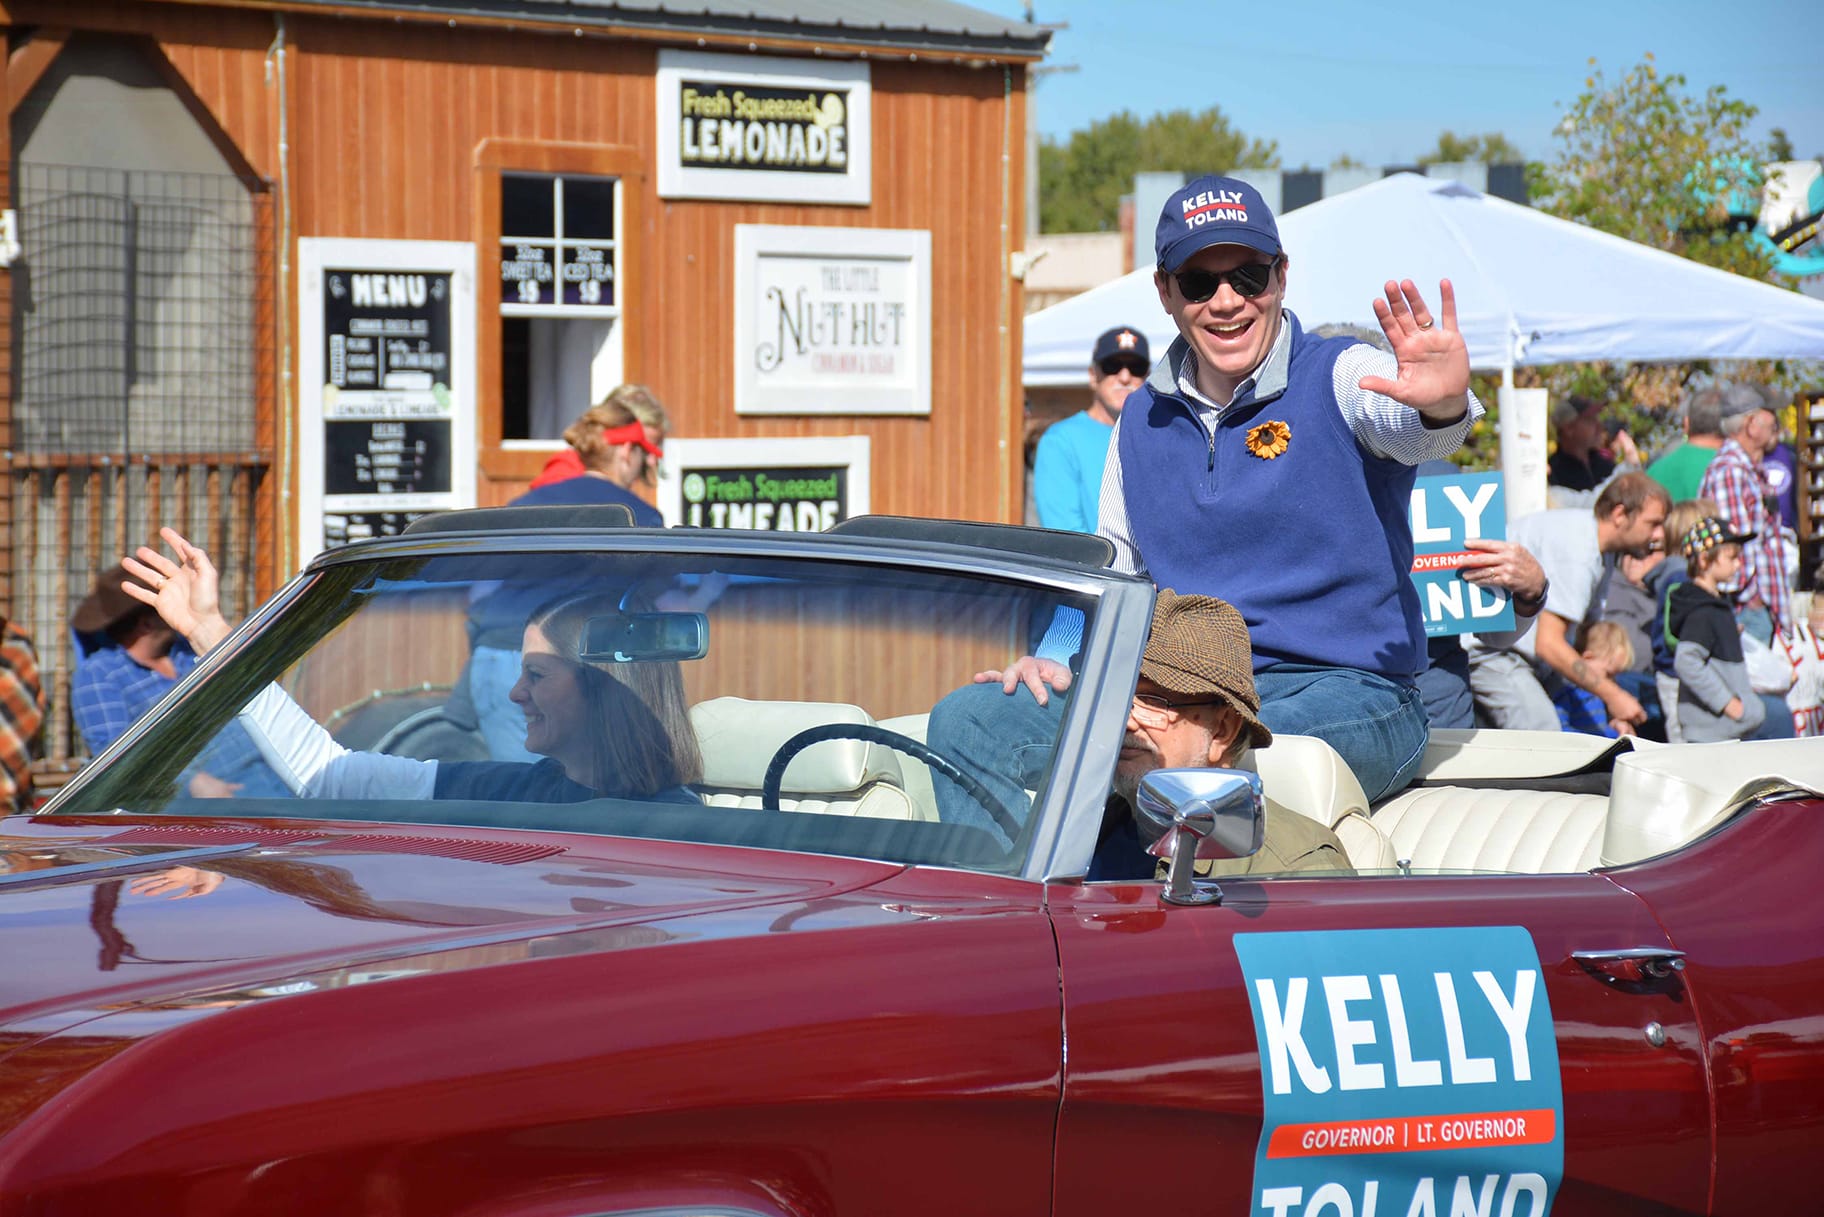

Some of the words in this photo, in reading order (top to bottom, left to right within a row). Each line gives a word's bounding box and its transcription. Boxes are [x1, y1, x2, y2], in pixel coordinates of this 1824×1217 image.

[682, 88, 731, 117] Fresh
[734, 91, 817, 121] Squeezed
[682, 117, 846, 165] LEMONADE
[1182, 190, 1243, 213] KELLY
[1185, 208, 1248, 229] TOLAND
[351, 274, 427, 307] MENU
[755, 286, 844, 373] NUT
[851, 302, 905, 346] HUT
[706, 475, 753, 500] Fresh
[755, 472, 838, 501] Squeezed
[1413, 554, 1473, 569] OVERN
[1255, 969, 1536, 1095] KELLY
[1302, 1126, 1395, 1149] GOVERNOR
[1417, 1123, 1436, 1143] LT.
[1442, 1117, 1526, 1142] GOVERNOR
